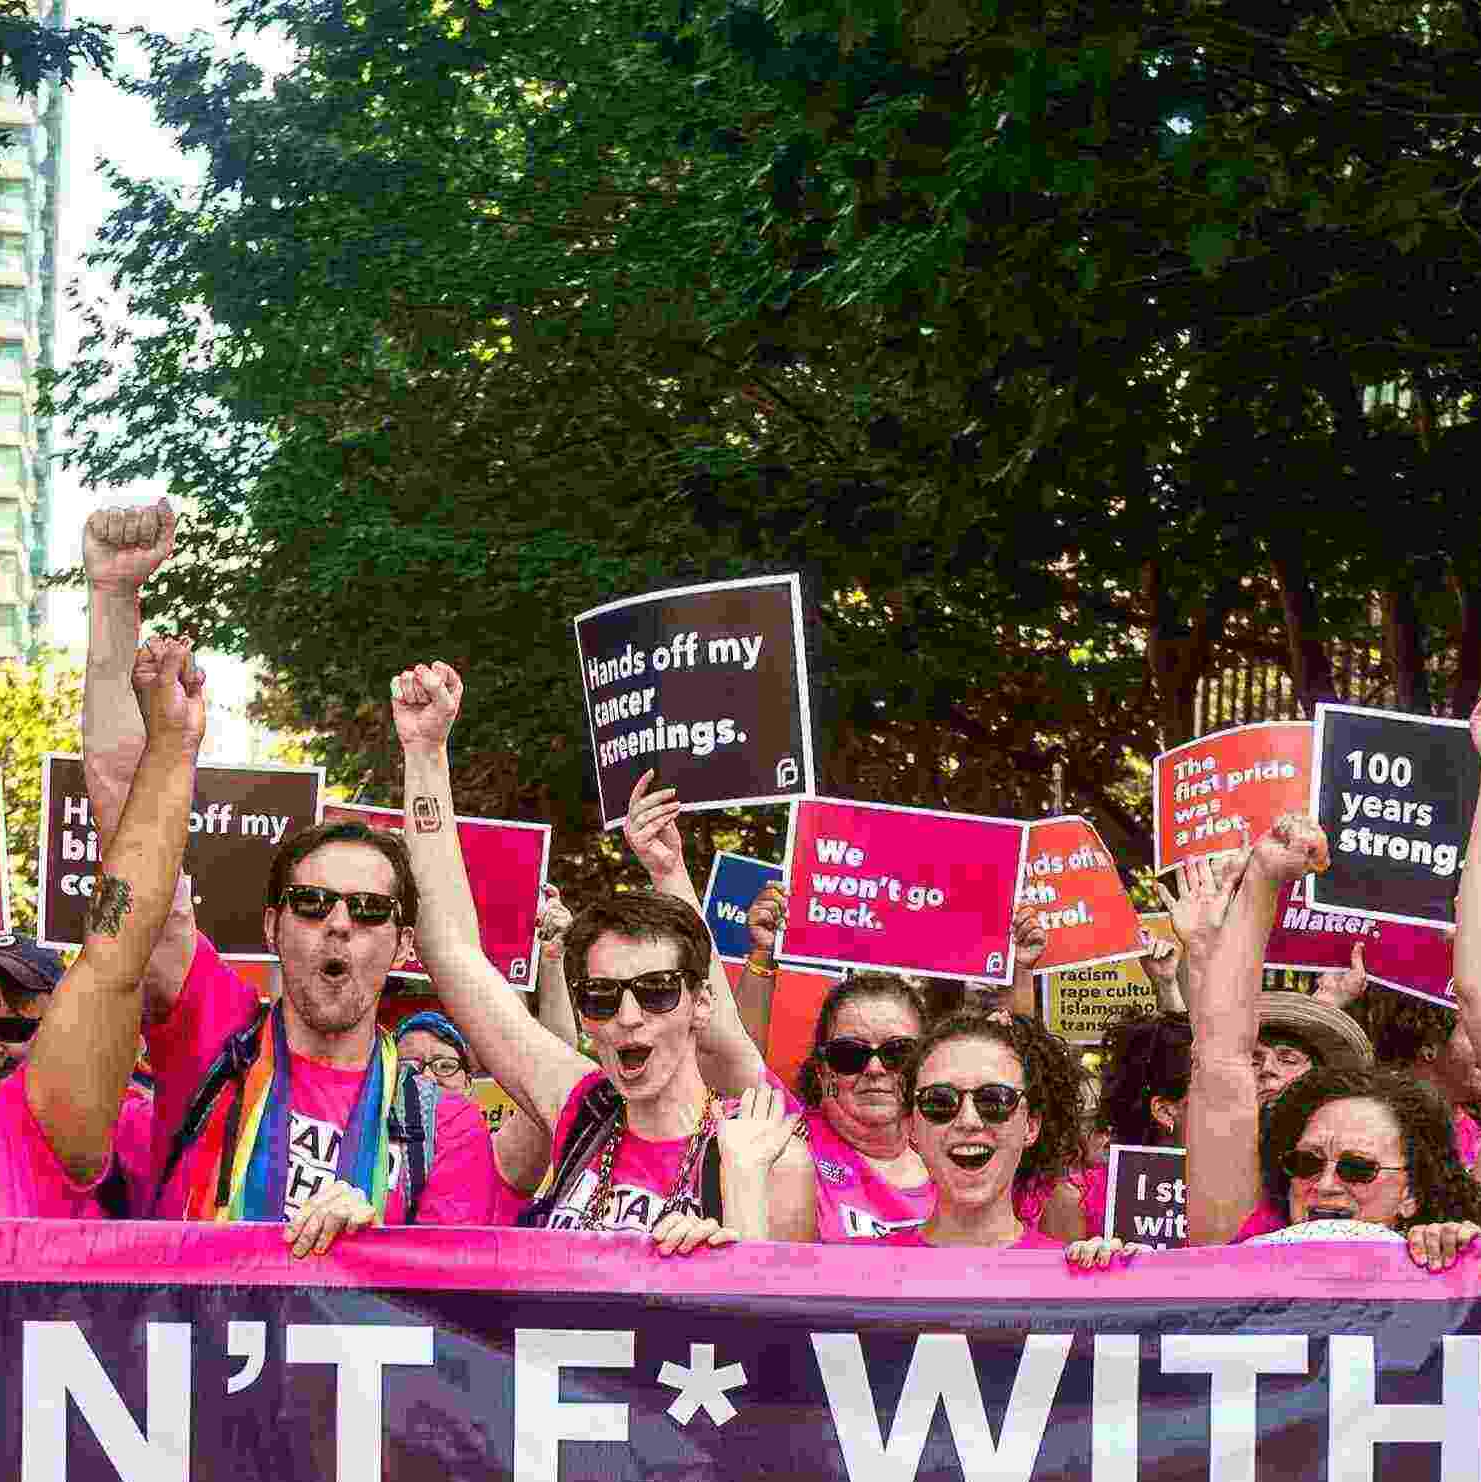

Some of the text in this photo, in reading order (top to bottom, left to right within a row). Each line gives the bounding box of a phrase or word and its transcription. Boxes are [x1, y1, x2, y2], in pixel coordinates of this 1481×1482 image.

[588, 632, 764, 690] Hands off my
[594, 687, 656, 728] cancer
[599, 715, 748, 768] screenings.
[1345, 750, 1412, 787] 100
[187, 802, 289, 845] off my
[1340, 791, 1433, 826] years
[815, 837, 865, 868] We
[807, 895, 884, 931] back.
[906, 885, 945, 911] go
